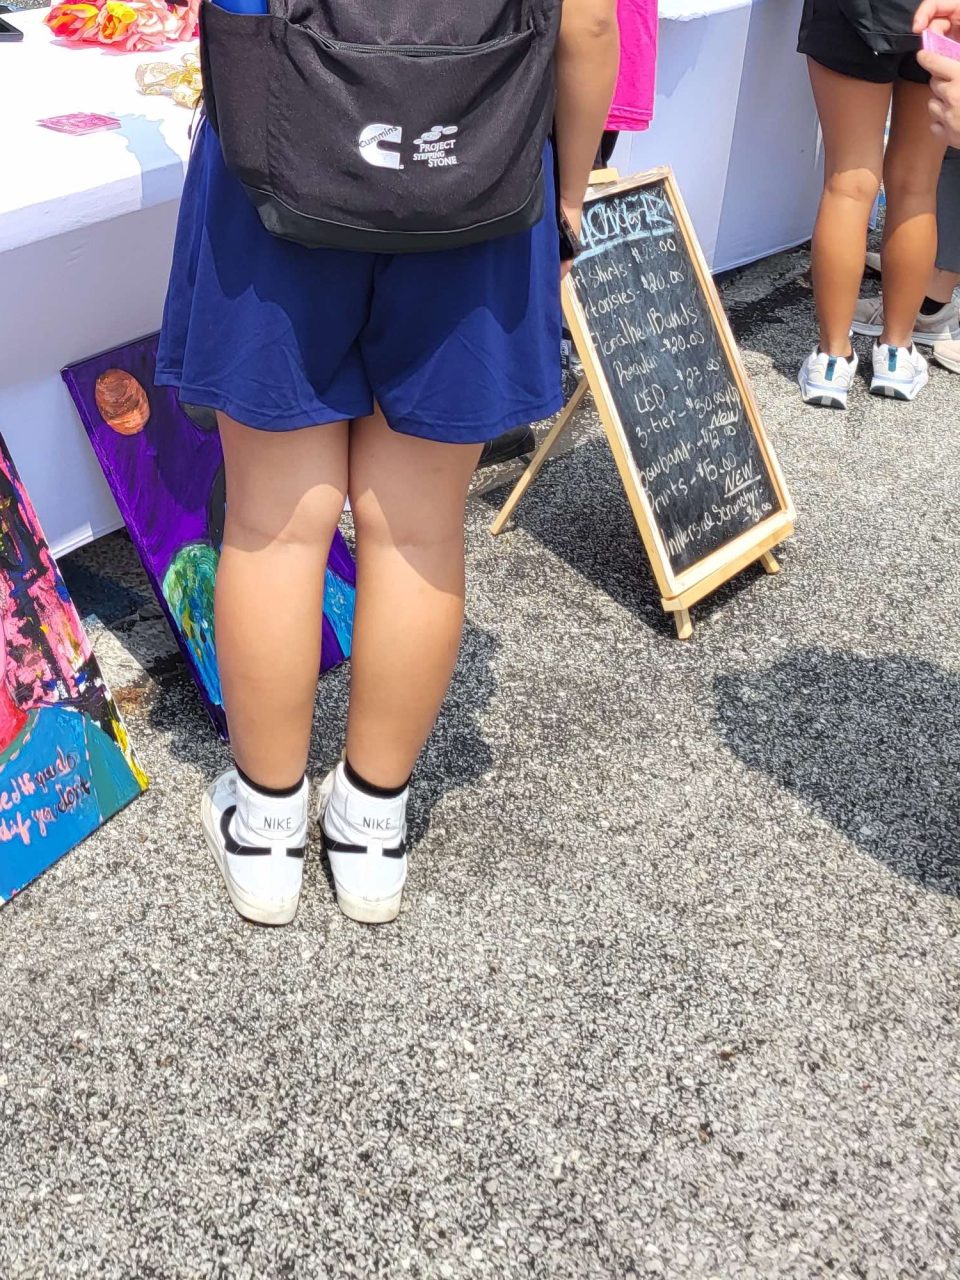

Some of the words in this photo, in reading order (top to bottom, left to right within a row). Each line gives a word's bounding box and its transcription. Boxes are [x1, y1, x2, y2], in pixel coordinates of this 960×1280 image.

[359, 126, 399, 148] Cummins
[419, 139, 457, 152] PROJECT
[412, 150, 446, 161] STEPPING
[427, 156, 458, 168] STONE
[634, 383, 666, 413] LED
[263, 816, 293, 831] NIKE
[362, 815, 392, 831] NIKE
